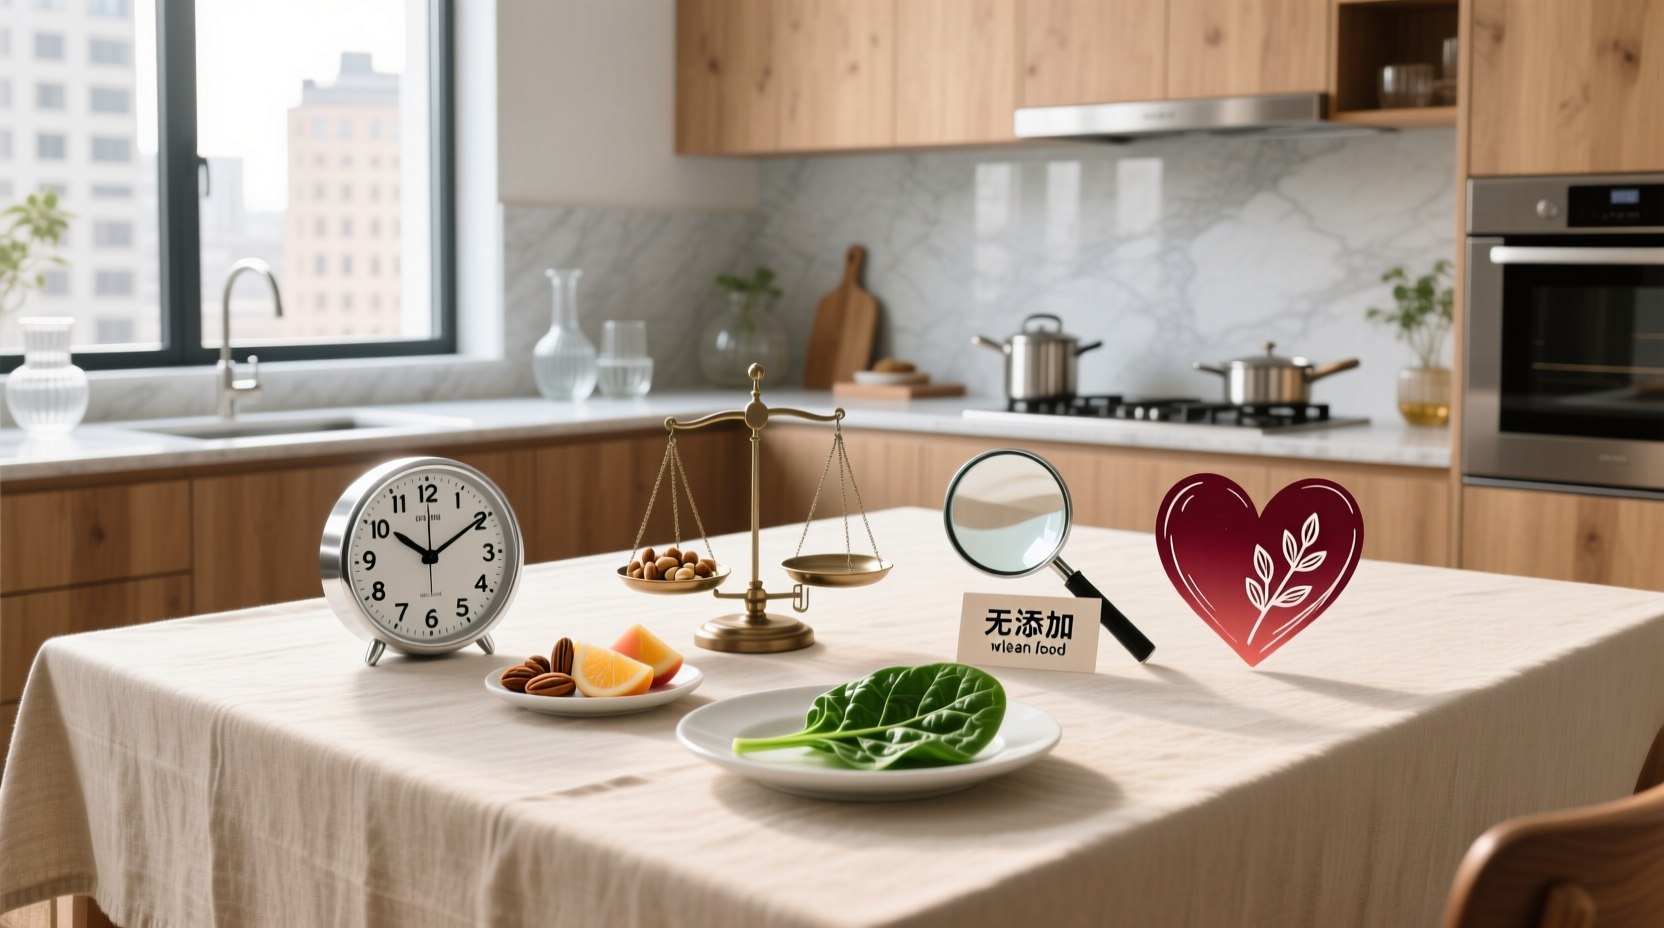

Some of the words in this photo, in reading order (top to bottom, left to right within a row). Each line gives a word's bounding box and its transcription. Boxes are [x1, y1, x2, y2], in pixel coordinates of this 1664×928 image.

[418, 484, 438, 503] 12
[455, 492, 460, 509] 1
[392, 494, 406, 513] 11
[371, 519, 390, 539] 10
[474, 511, 487, 530] 2
[362, 550, 376, 571] 9
[482, 543, 495, 562] 3
[372, 581, 386, 601] 8
[474, 574, 488, 592] 4
[395, 603, 409, 622] 7
[456, 598, 469, 617] 5
[425, 609, 439, 628] 6
[984, 608, 1074, 640] 无添加
